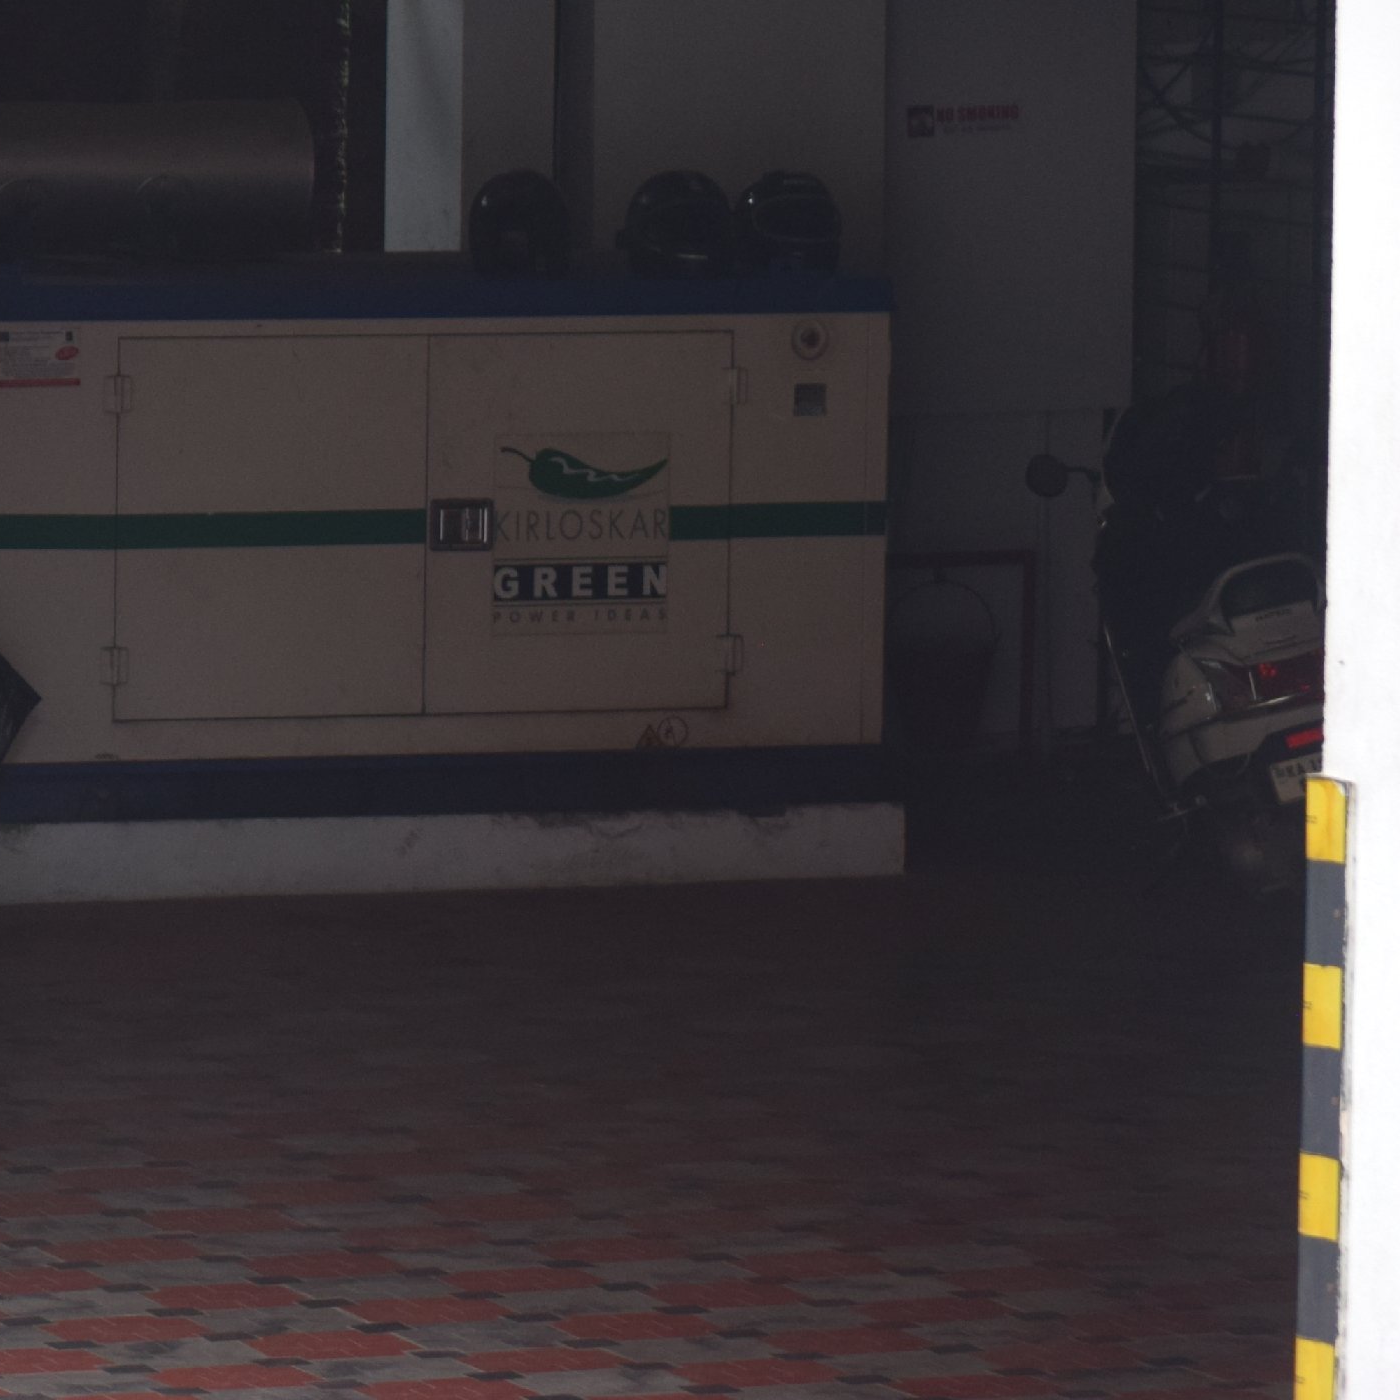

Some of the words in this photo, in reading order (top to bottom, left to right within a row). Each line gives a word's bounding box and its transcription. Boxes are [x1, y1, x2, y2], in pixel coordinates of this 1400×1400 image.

[496, 508, 667, 543] KIRLOSKAR
[493, 564, 668, 600] GREEN
[491, 609, 576, 624] POWER
[594, 607, 668, 622] IDEAS
